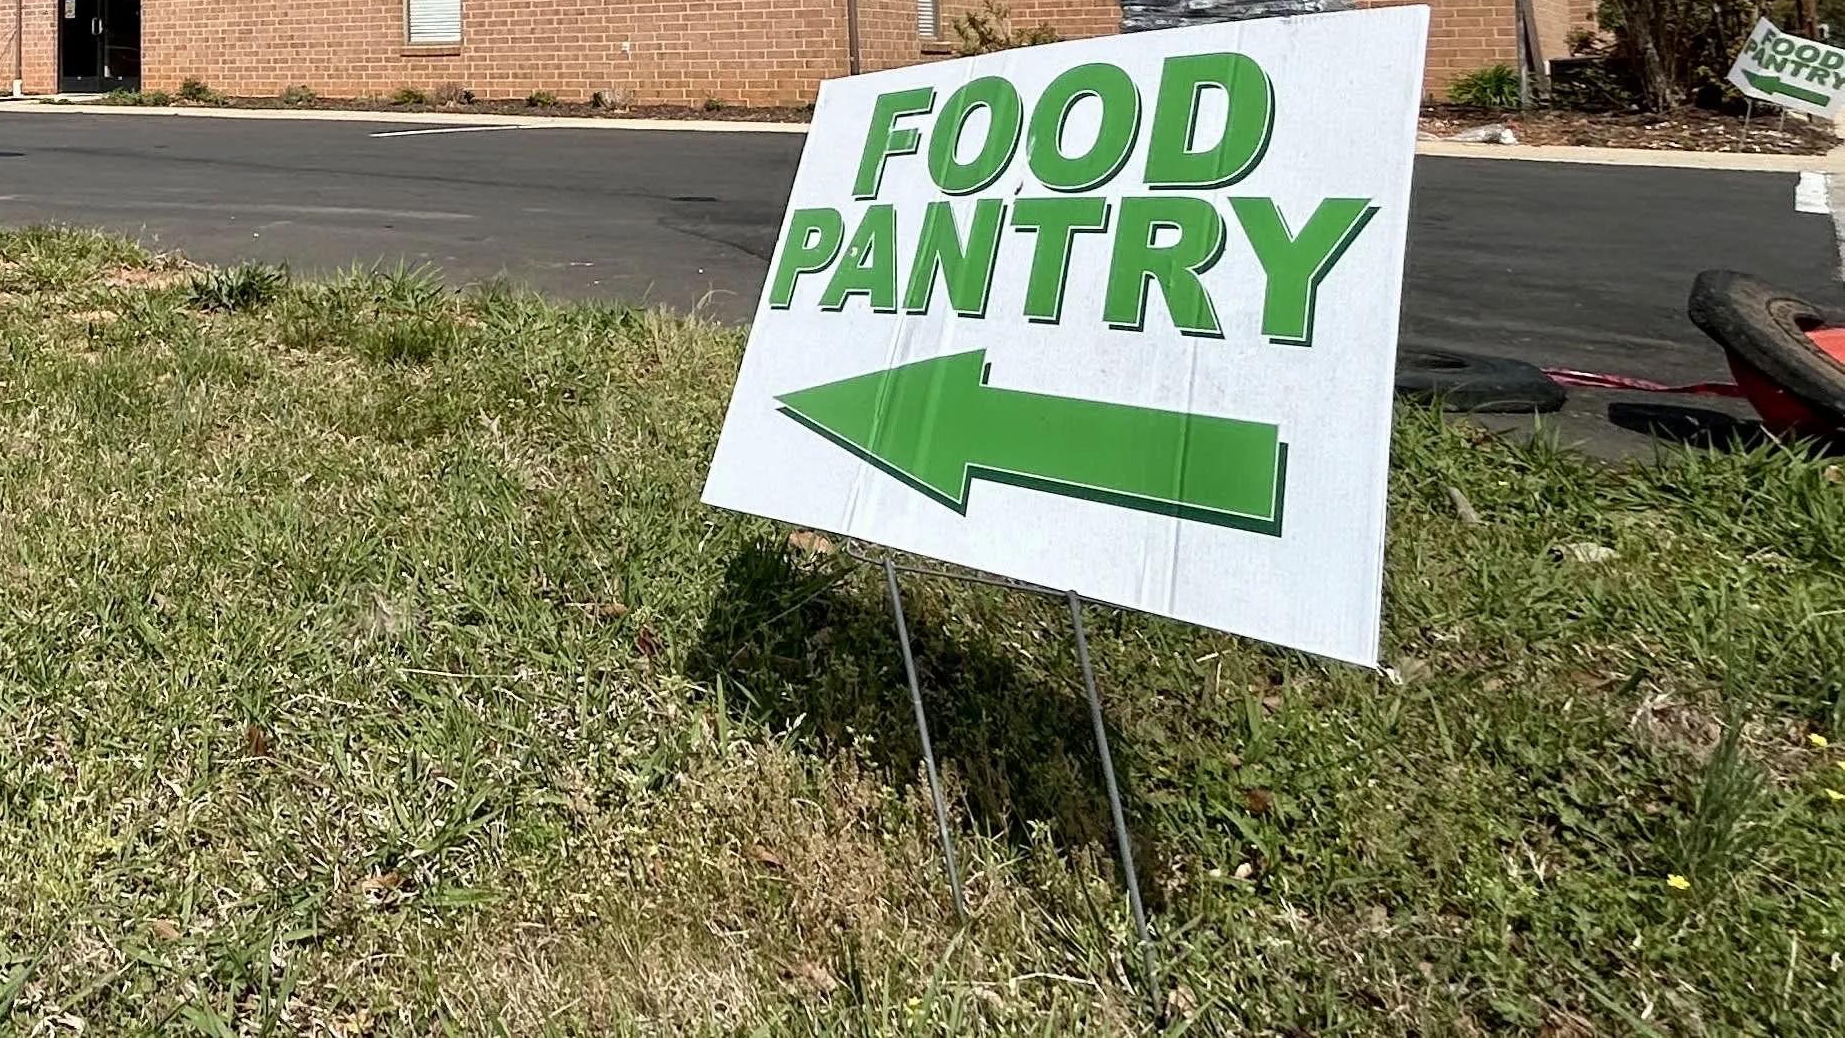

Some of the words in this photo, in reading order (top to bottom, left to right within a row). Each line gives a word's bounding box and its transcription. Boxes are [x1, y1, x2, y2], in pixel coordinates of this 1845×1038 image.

[1744, 38, 1845, 90] PANTRY
[1761, 28, 1844, 70] FOOD
[852, 51, 1276, 199] FOOD
[769, 196, 1380, 347] PANTRY
